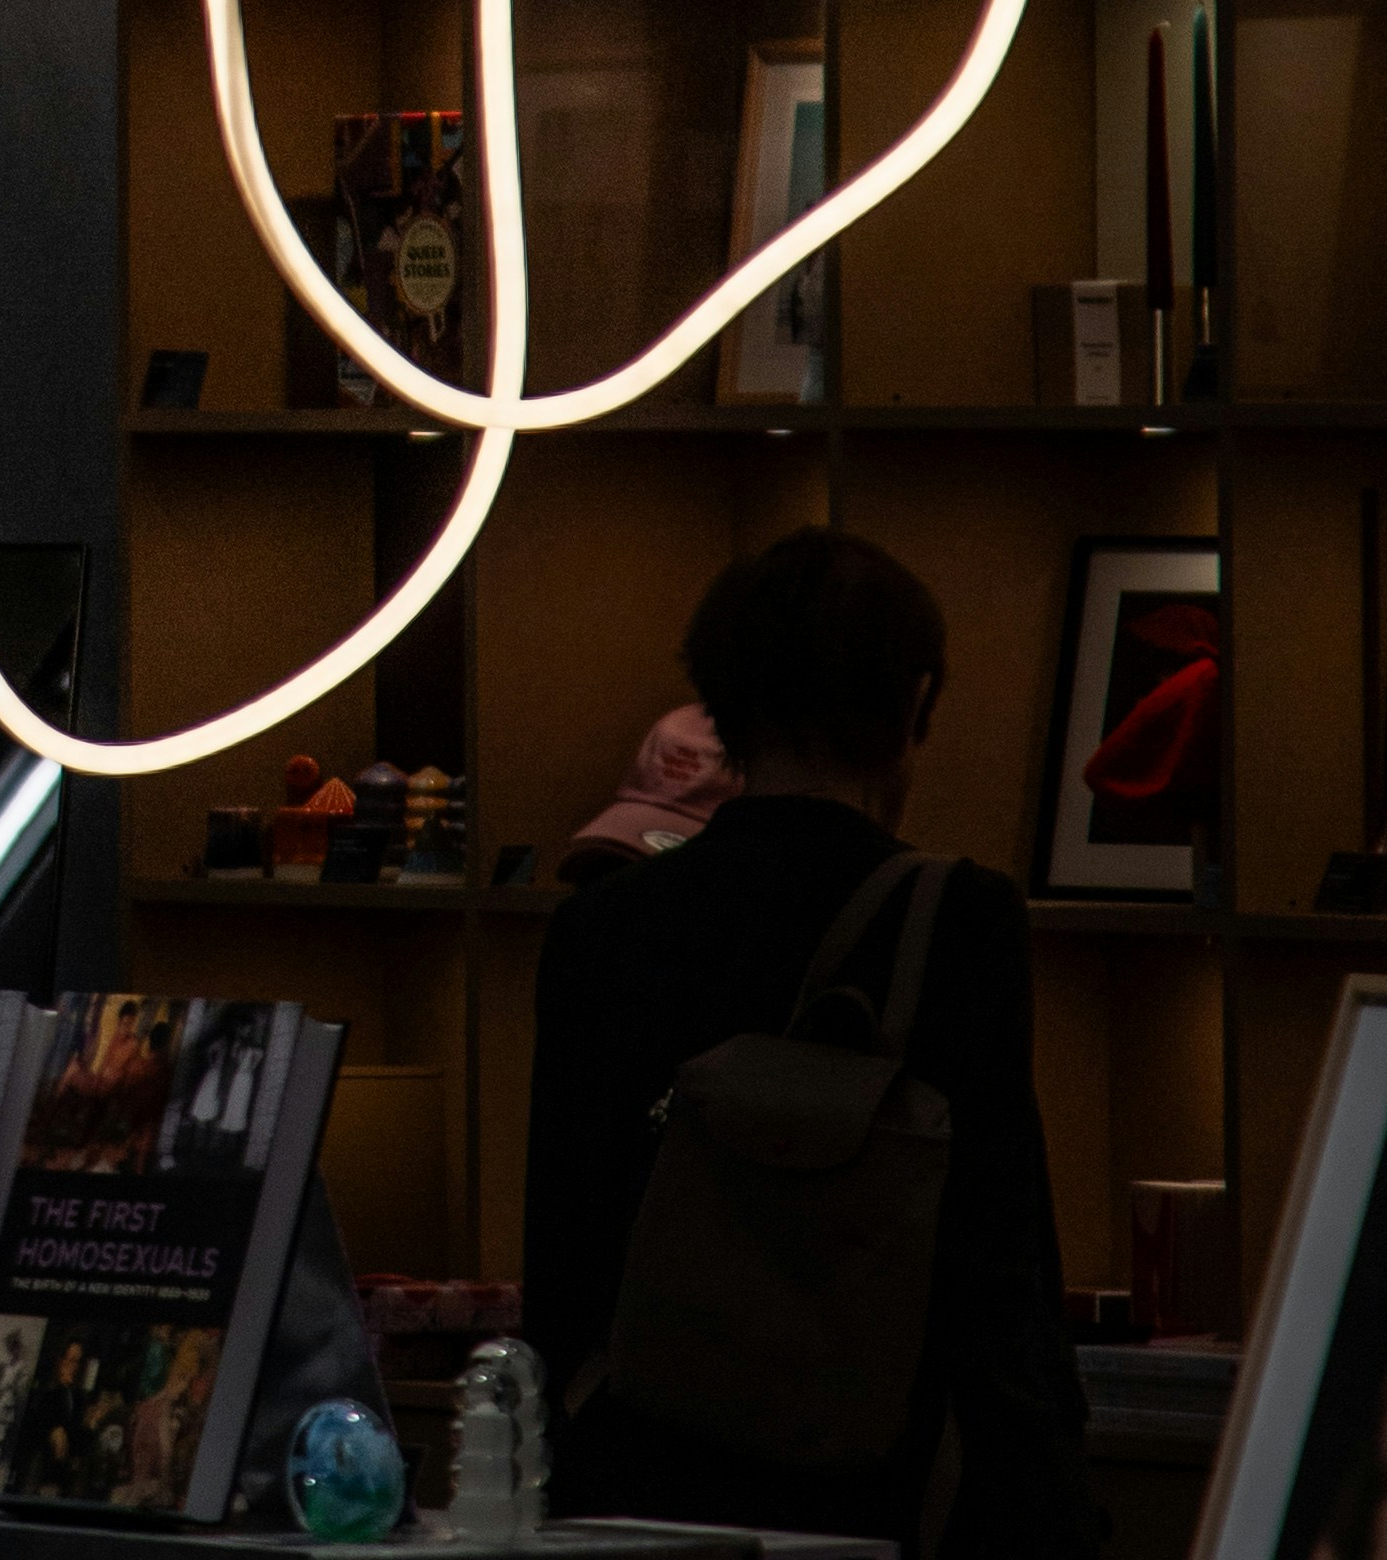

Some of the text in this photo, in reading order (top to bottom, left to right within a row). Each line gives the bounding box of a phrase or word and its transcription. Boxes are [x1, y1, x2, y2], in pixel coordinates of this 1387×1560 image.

[407, 246, 445, 260] QUEER
[404, 262, 450, 278] STORIES
[30, 1195, 167, 1232] THE FIRST
[16, 1237, 221, 1278] HOMOSEXUALS
[11, 1275, 30, 1290] THE
[31, 1278, 63, 1292] BIRTH
[78, 1282, 87, 1293] A
[112, 1283, 158, 1297] IDENTITY
